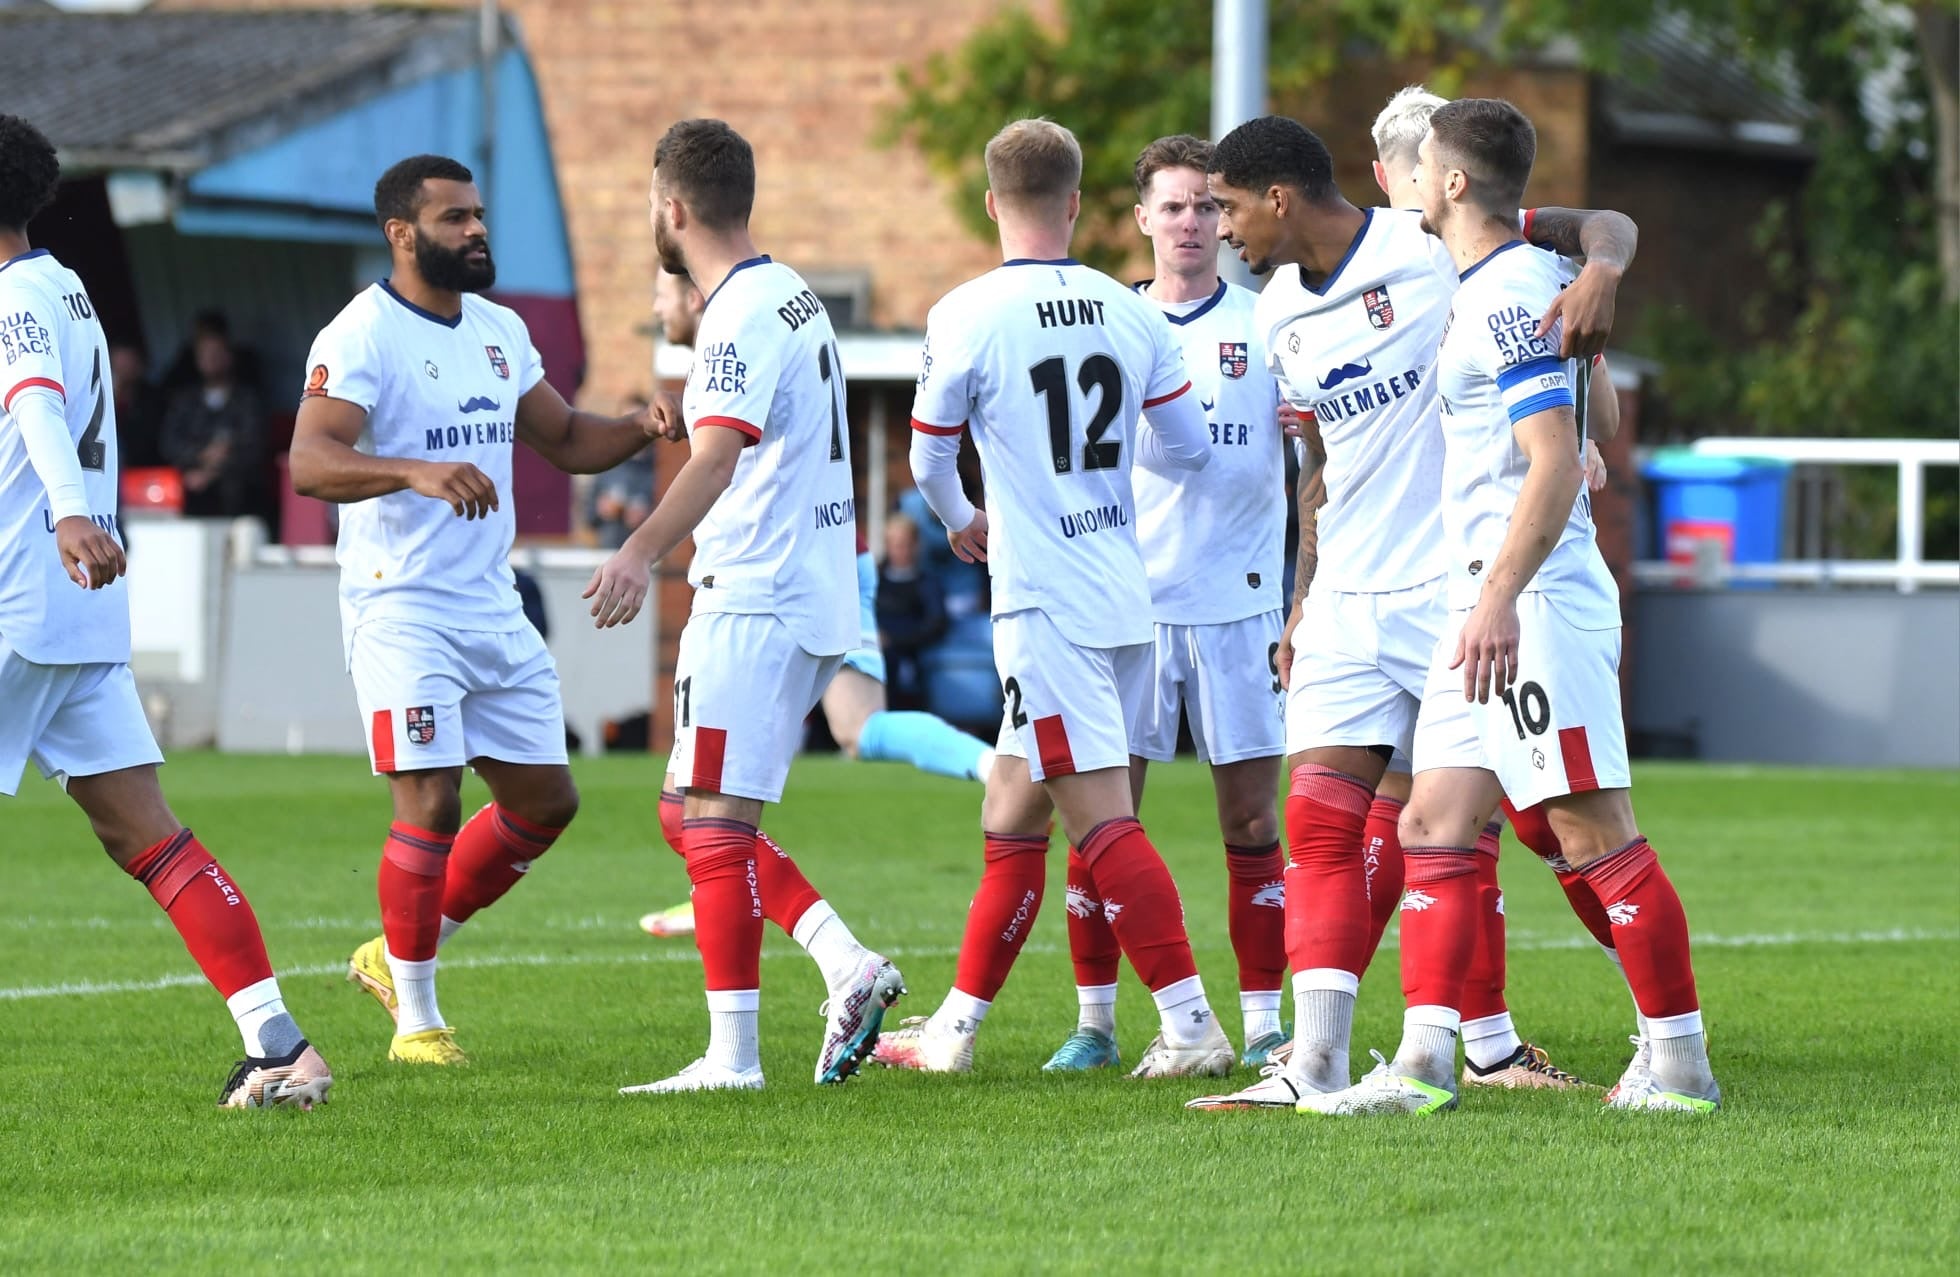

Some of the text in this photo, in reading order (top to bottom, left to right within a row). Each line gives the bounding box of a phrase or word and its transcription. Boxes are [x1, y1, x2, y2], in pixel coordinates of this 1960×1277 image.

[777, 290, 824, 332] DEAD
[1036, 299, 1105, 328] HUNT
[1488, 306, 1531, 332] QUA
[2, 326, 50, 350] RTER
[6, 341, 55, 365] BACK
[705, 359, 747, 378] TER
[77, 345, 106, 473] 2
[1029, 353, 1122, 475] 12
[426, 422, 513, 450] MOVEMBE
[1005, 676, 1028, 729] 2
[1502, 680, 1550, 740] 10
[746, 860, 761, 918] BEAVERS
